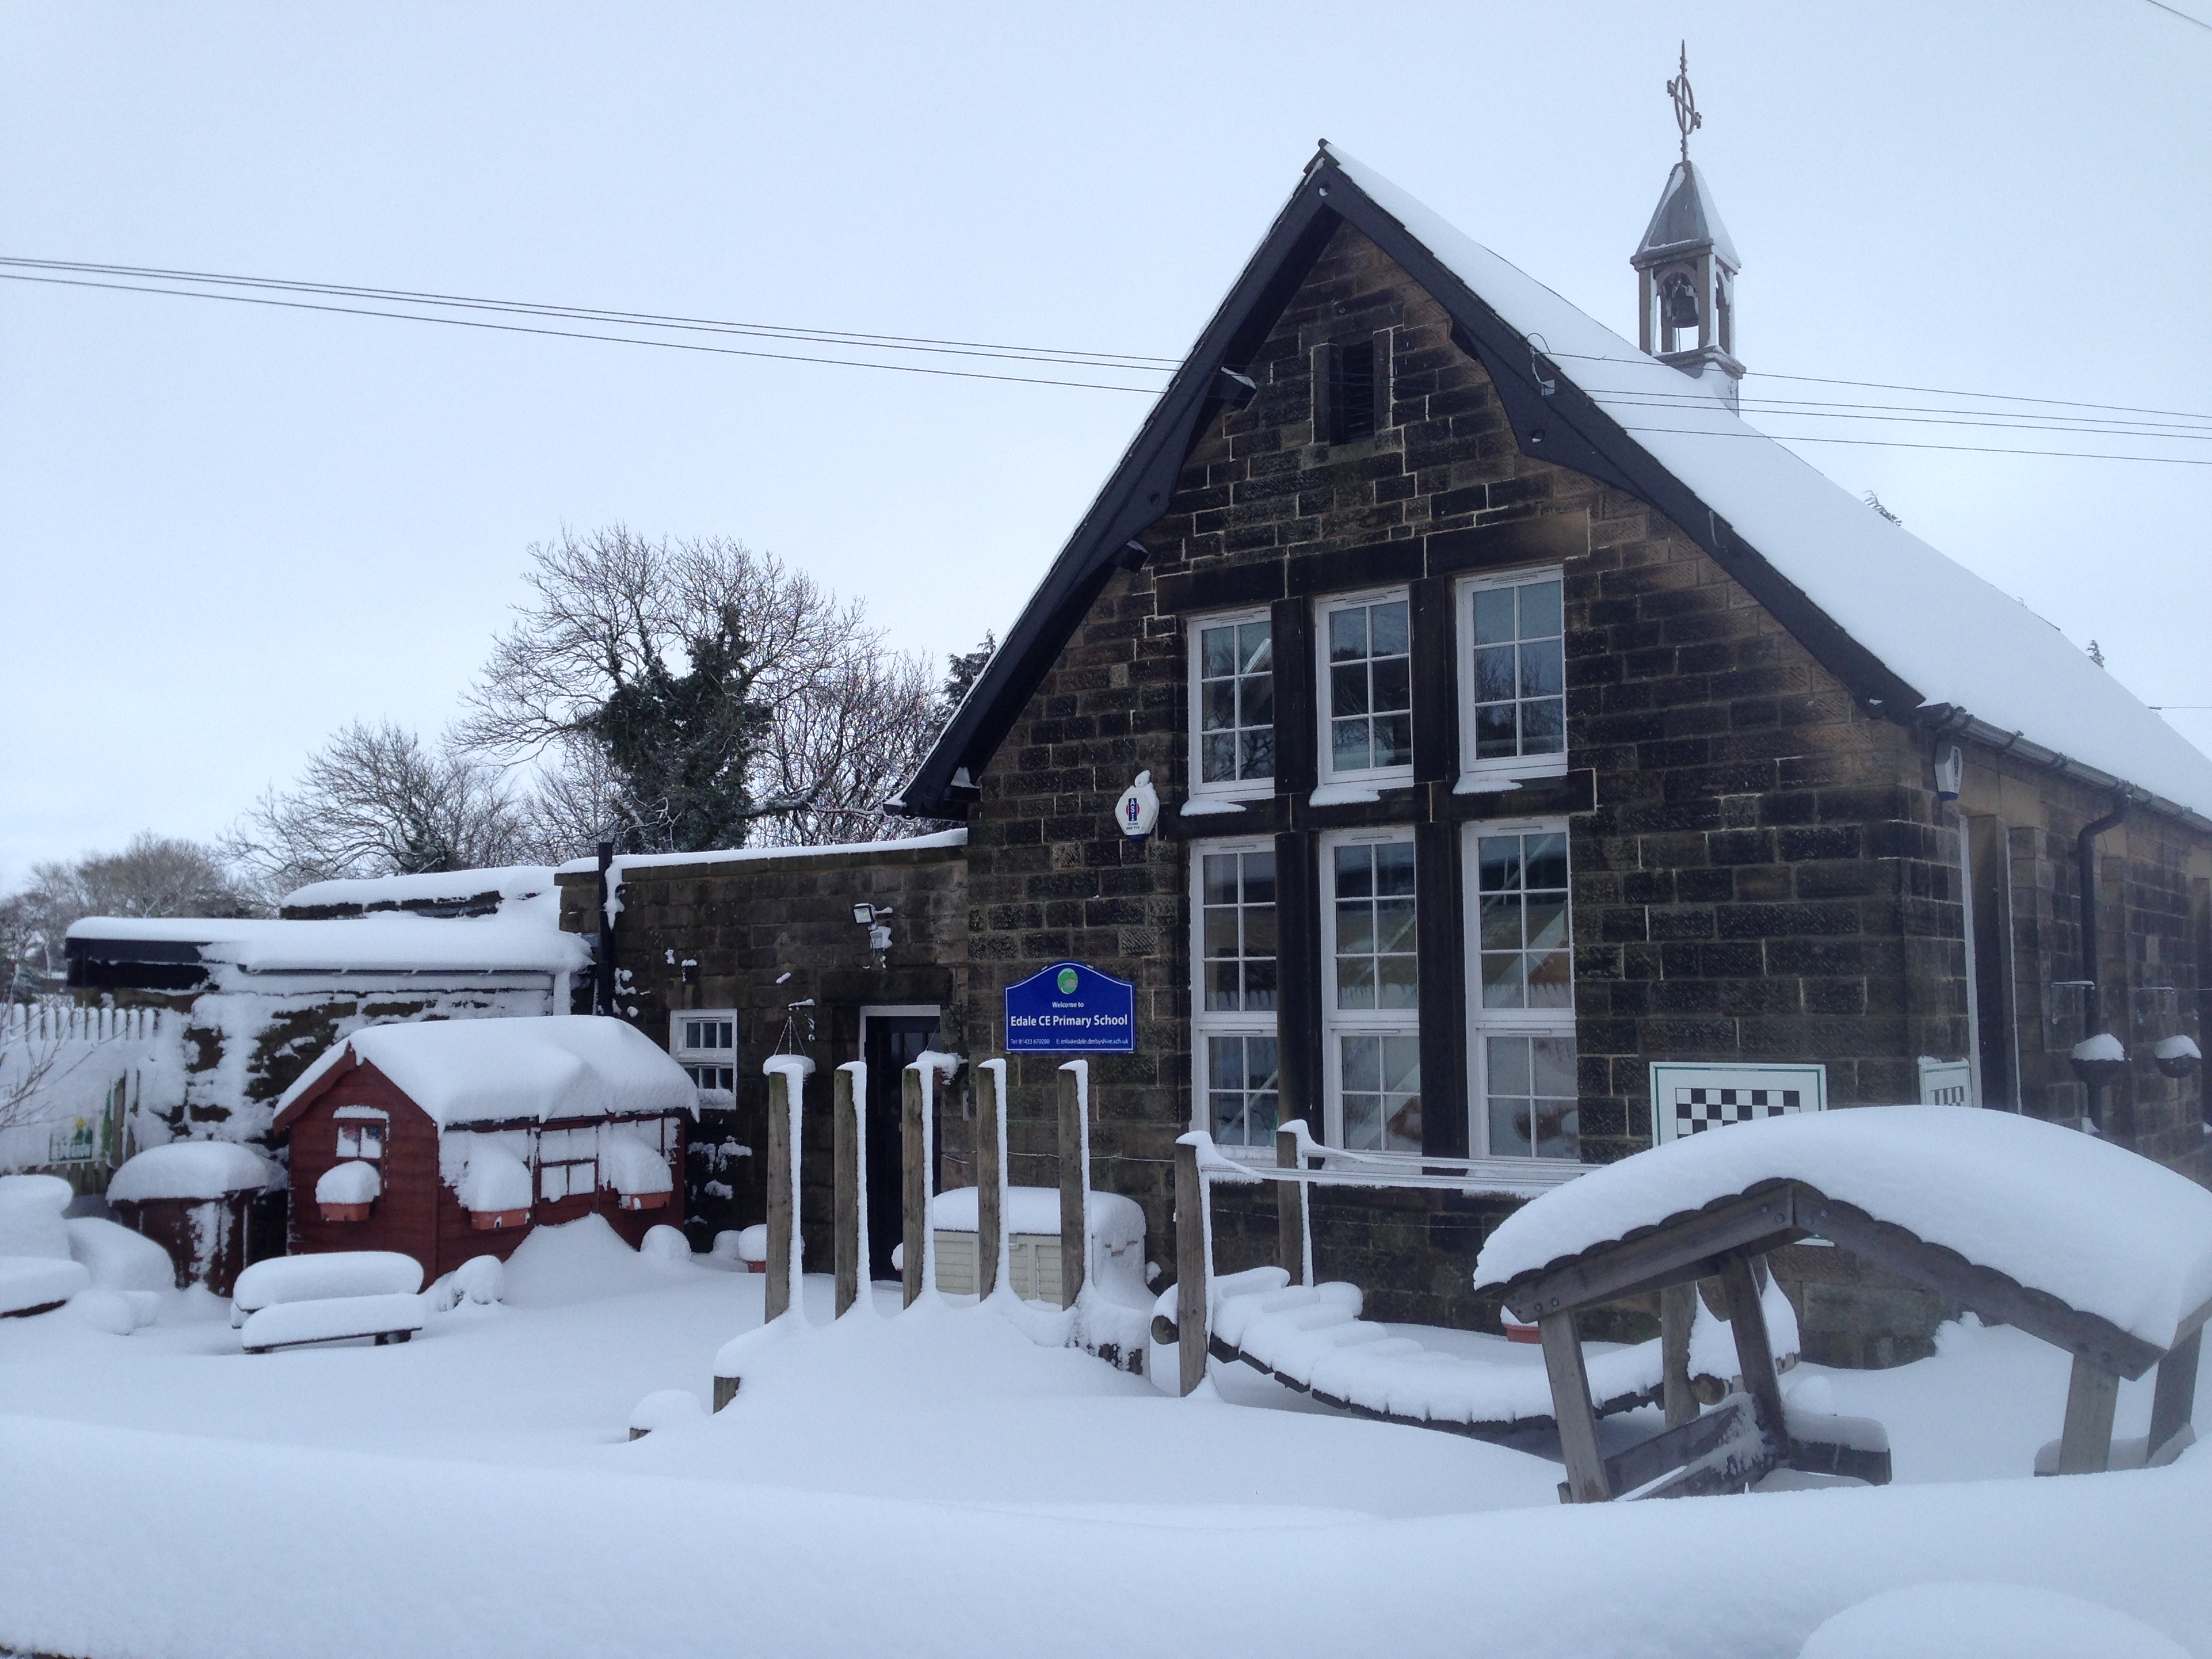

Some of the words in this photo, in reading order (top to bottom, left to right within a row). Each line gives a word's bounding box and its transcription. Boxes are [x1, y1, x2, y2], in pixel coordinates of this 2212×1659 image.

[1010, 1015, 1037, 1026] Edale
[1039, 1016, 1050, 1026] CE
[1052, 1015, 1092, 1028] Primary
[1094, 1015, 1128, 1026] School
